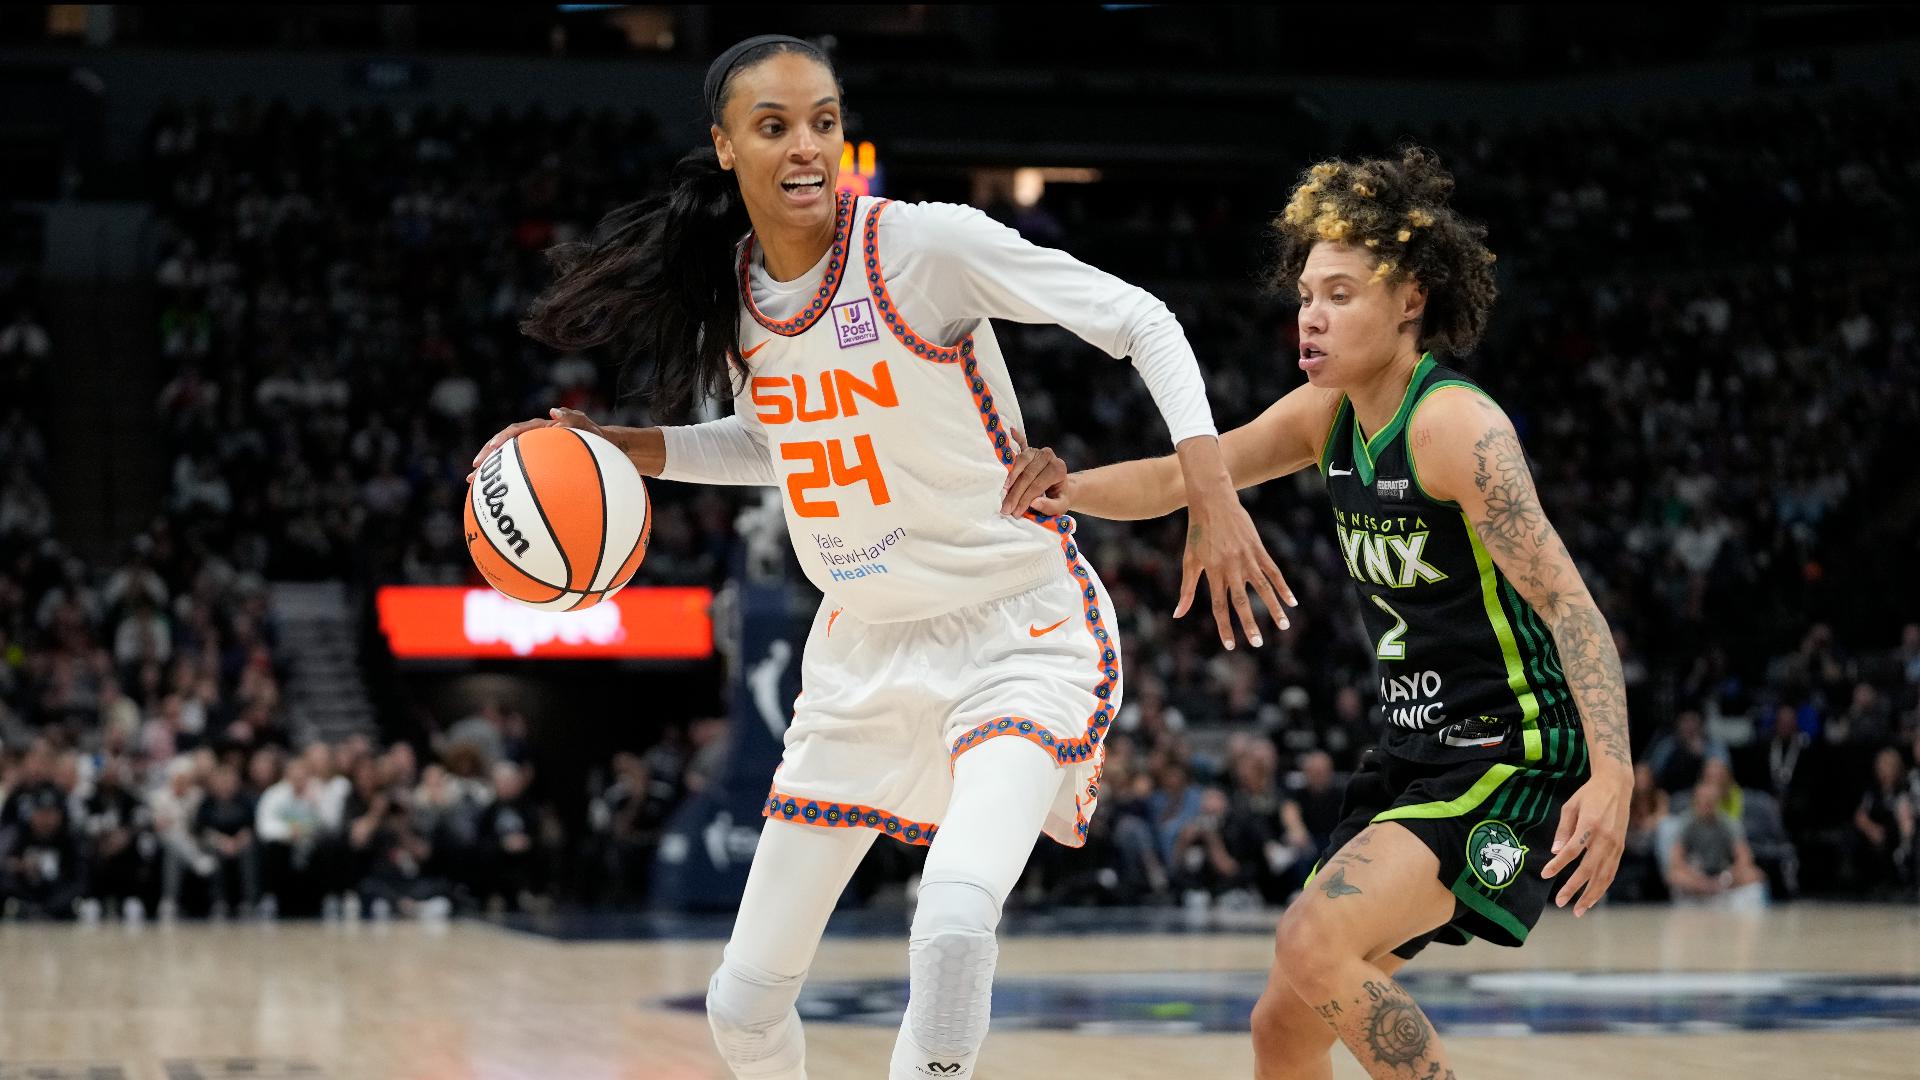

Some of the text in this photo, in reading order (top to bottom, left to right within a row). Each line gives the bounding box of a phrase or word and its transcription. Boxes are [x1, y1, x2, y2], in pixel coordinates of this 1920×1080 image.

[841, 321, 873, 338] Post
[752, 360, 899, 424] SUN
[780, 434, 891, 518] 24
[480, 449, 530, 558] Wilson
[812, 533, 844, 549] Yale
[820, 527, 906, 566] NewHaven
[829, 563, 889, 582] Health
[1371, 594, 1408, 660] 2
[1381, 701, 1447, 730] INIC
